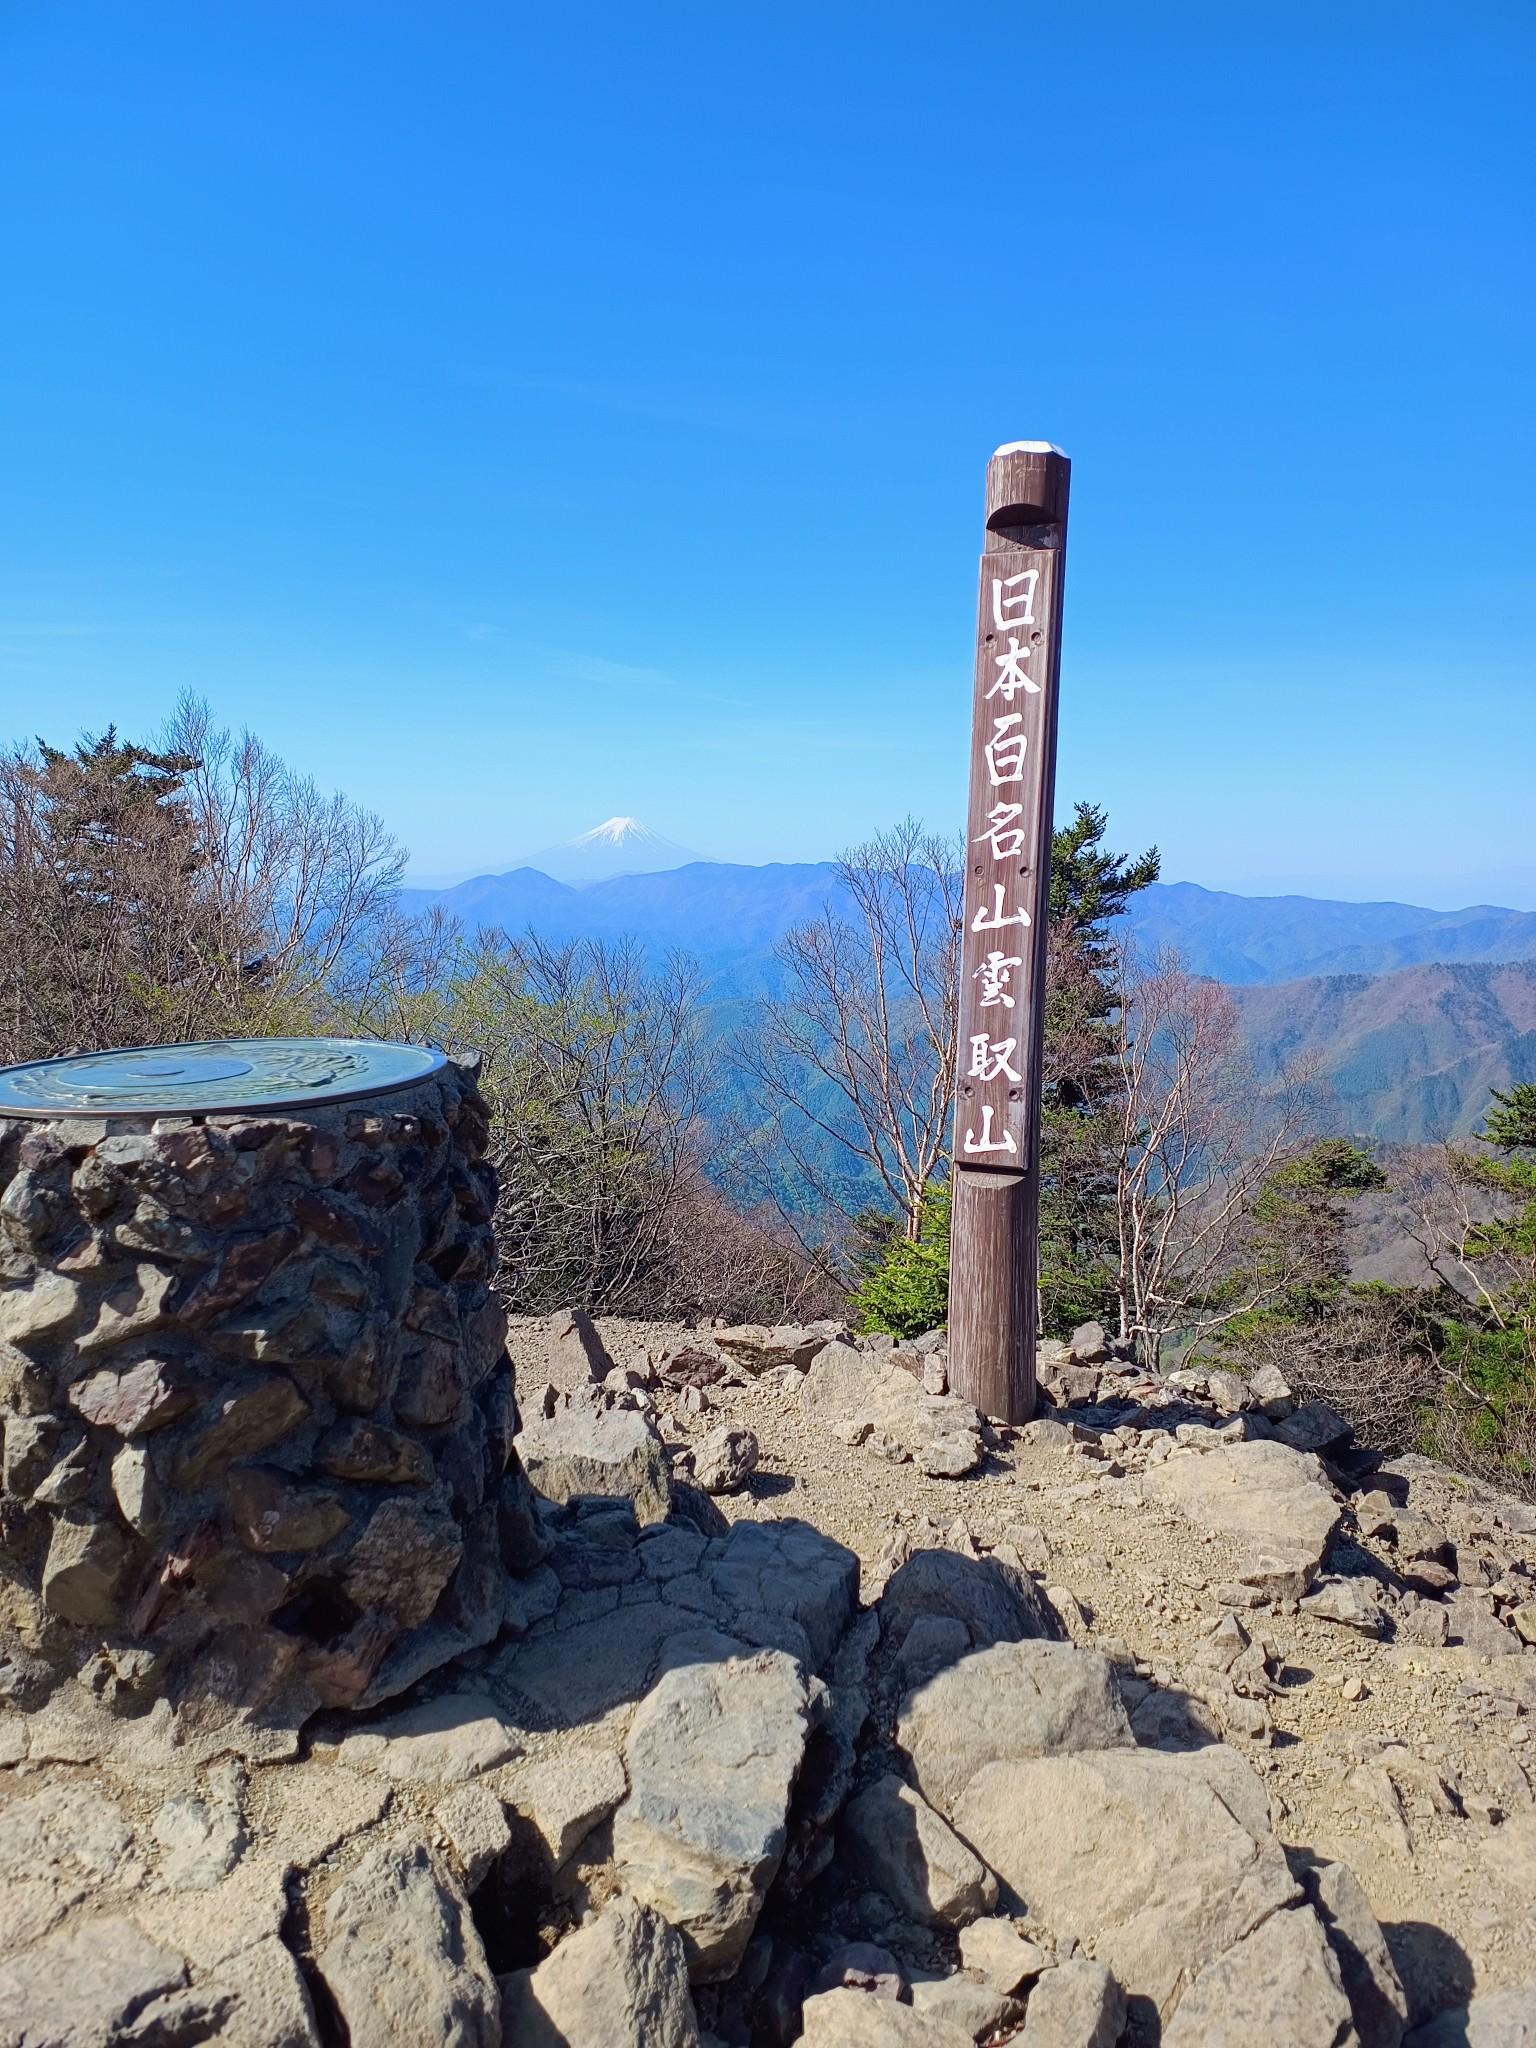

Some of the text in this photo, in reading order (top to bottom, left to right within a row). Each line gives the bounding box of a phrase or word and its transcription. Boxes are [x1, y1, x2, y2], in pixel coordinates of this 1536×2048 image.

[963, 568, 1041, 1154] 日本百名山雲取山
